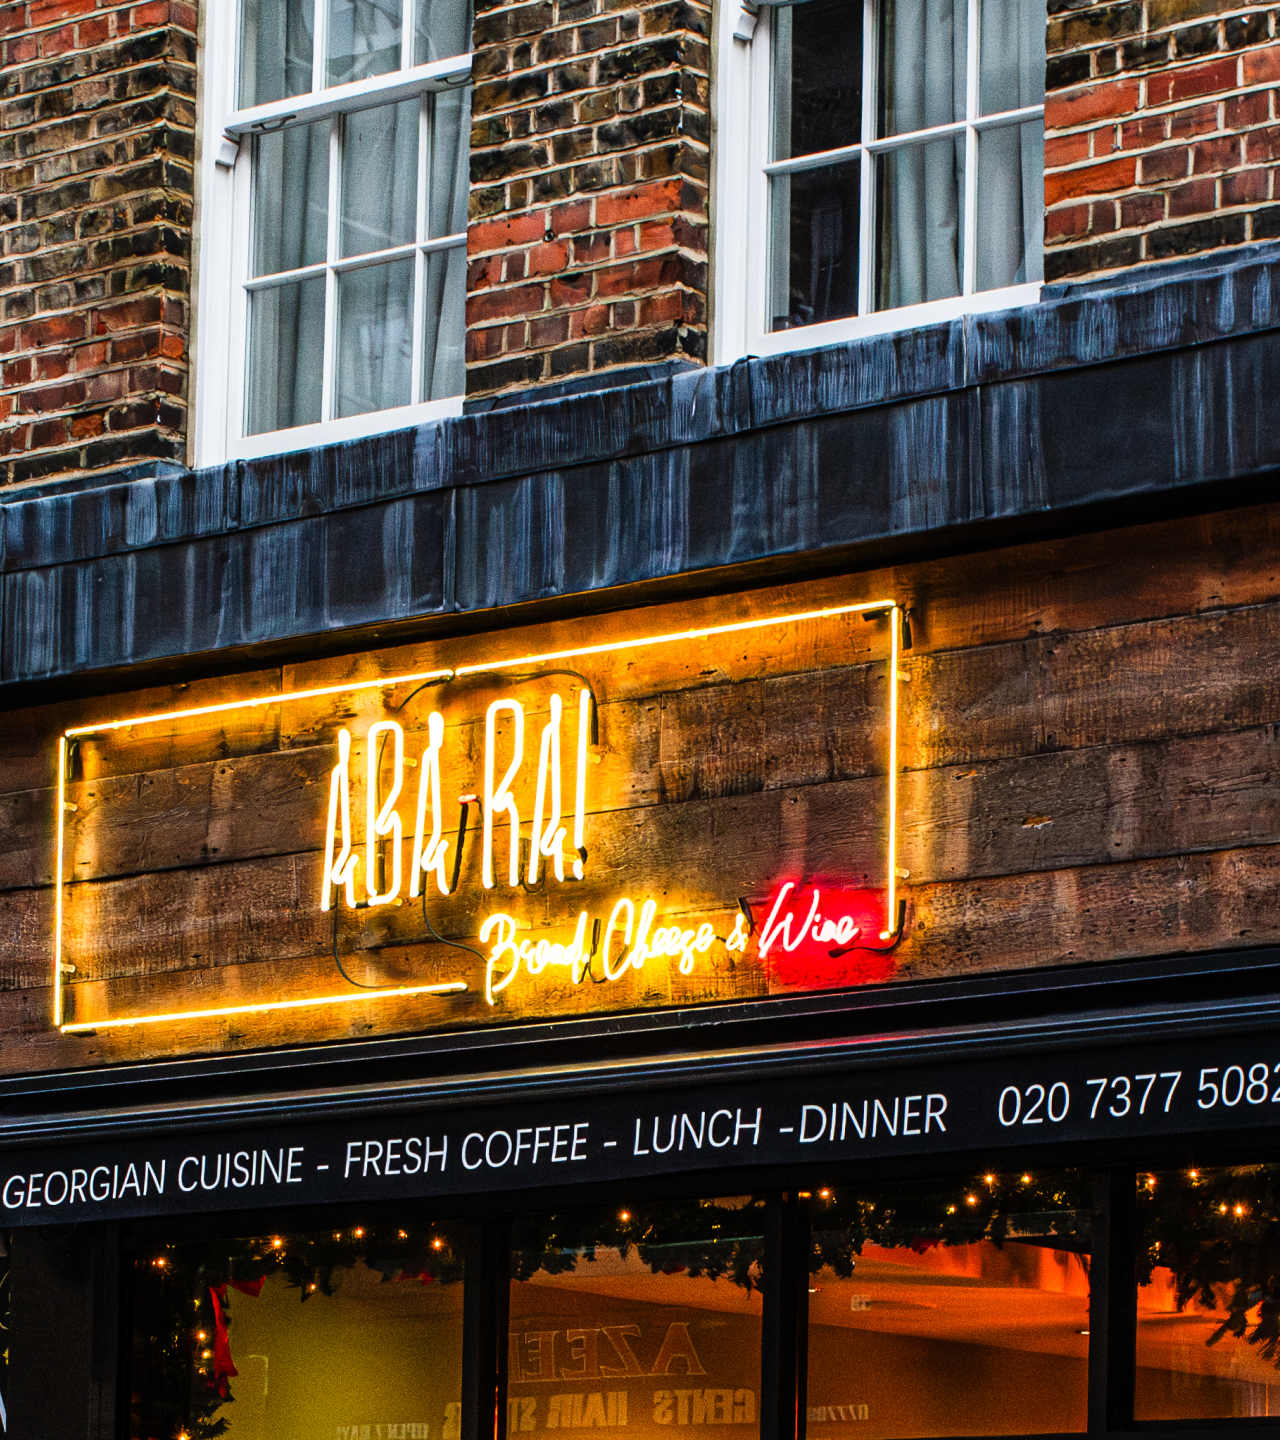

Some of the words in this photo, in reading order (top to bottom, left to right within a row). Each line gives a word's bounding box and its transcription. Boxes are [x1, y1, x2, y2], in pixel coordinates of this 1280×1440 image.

[758, 882, 860, 958] Wine
[2, 1160, 166, 1209] GEORGIAN
[177, 1147, 305, 1192] CUISINE
[344, 1135, 448, 1179] FRESH
[461, 1123, 590, 1170] COFFEE
[632, 1108, 762, 1156] LUNCH
[998, 1081, 1070, 1127] 020
[1085, 1071, 1181, 1119] 7377
